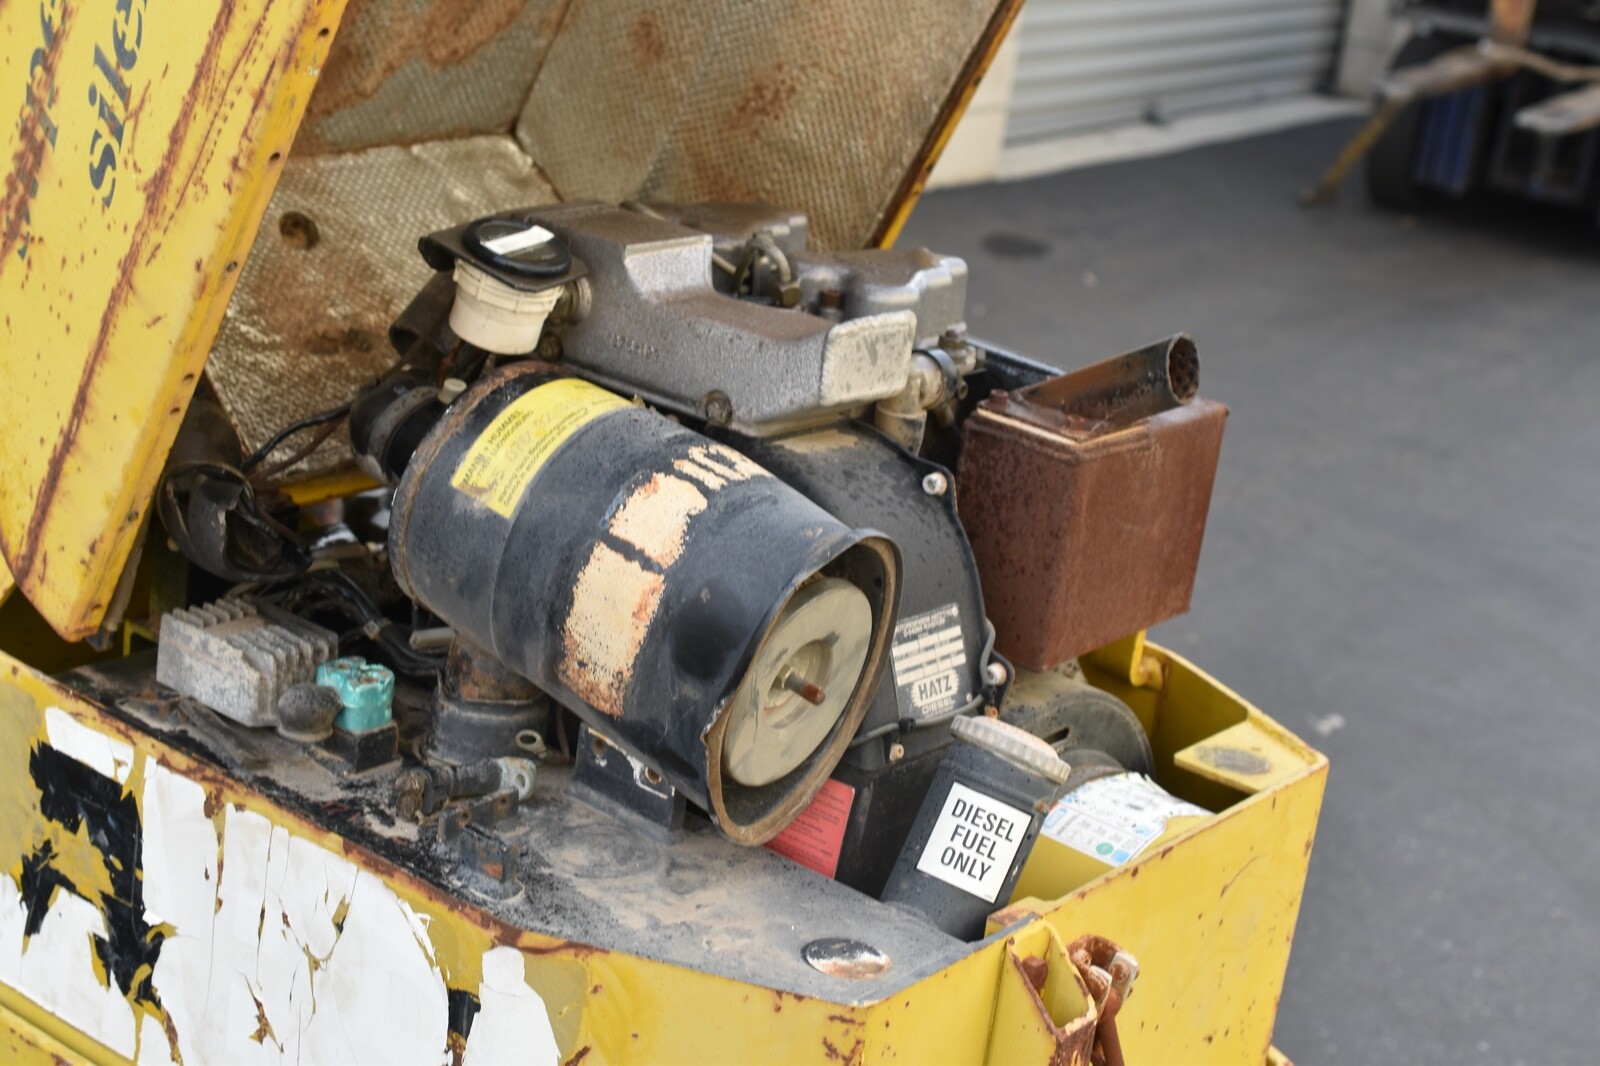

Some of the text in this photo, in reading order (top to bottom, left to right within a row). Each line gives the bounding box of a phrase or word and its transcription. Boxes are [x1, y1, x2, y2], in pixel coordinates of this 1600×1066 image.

[89, 0, 147, 209] sile
[487, 410, 523, 444] HUMMEL
[918, 675, 952, 701] HATZ
[922, 697, 955, 715] DIESEL
[951, 798, 1014, 842] DIESEL
[950, 824, 996, 861] FUEL
[940, 846, 992, 882] ONLY
